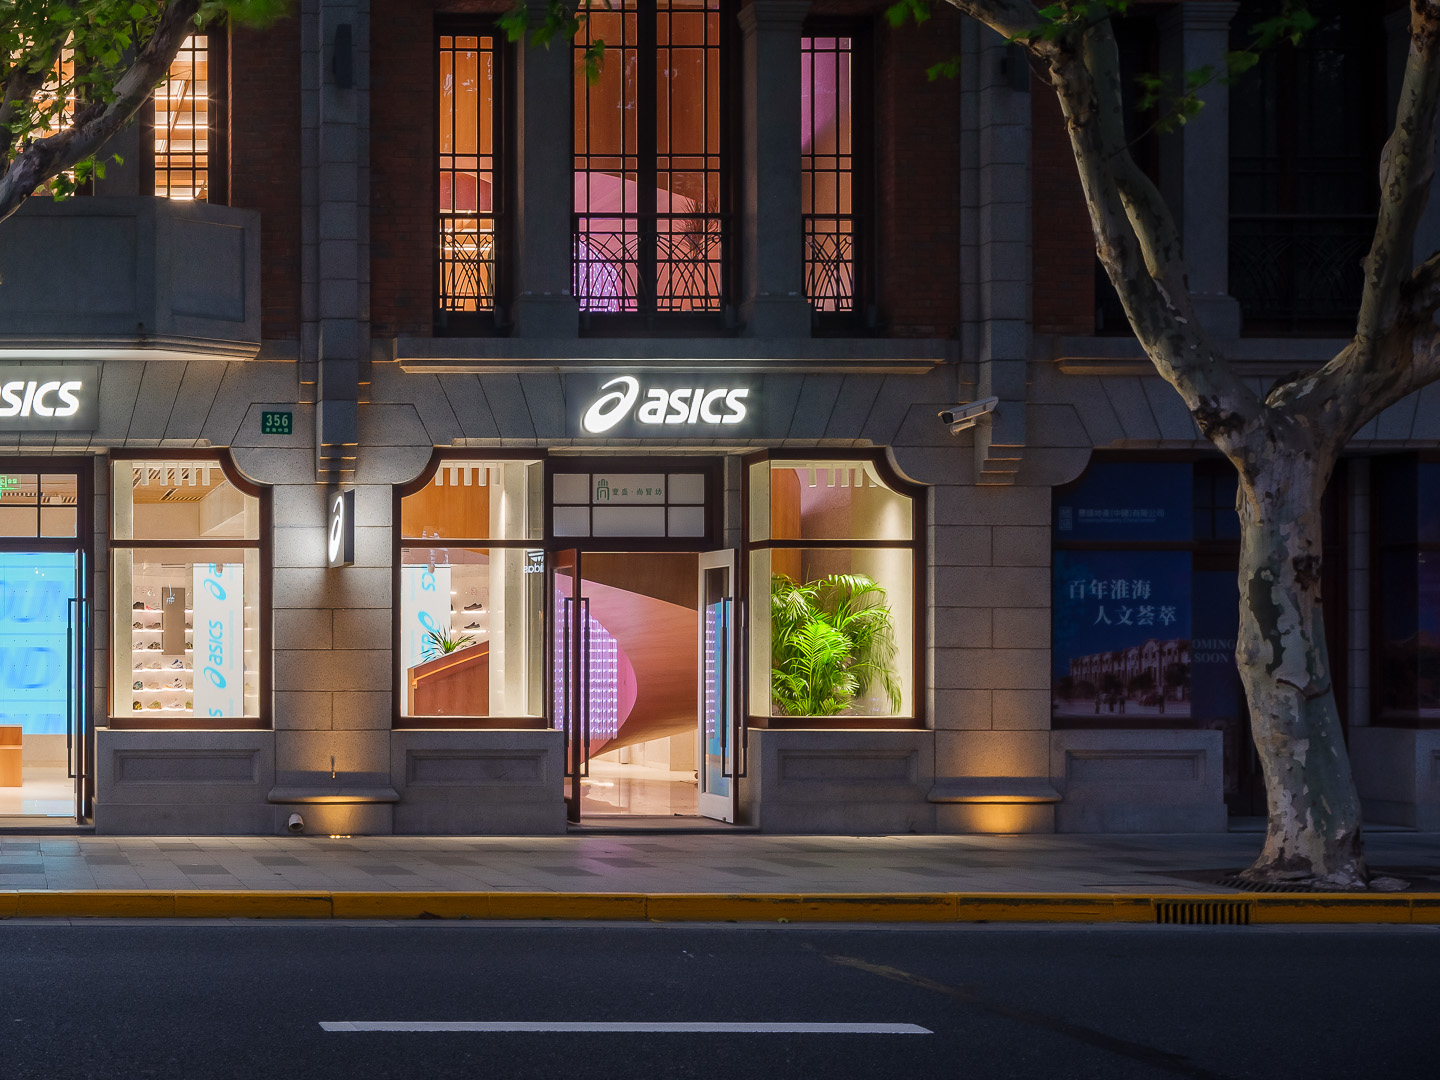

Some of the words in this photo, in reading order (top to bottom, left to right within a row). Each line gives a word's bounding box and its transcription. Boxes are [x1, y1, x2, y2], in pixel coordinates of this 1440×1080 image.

[638, 388, 750, 424] asics
[266, 414, 288, 427] 356
[1068, 579, 1152, 600] 百年淮海
[1092, 605, 1177, 626] 人文荟萃
[1193, 652, 1229, 664] SOON
